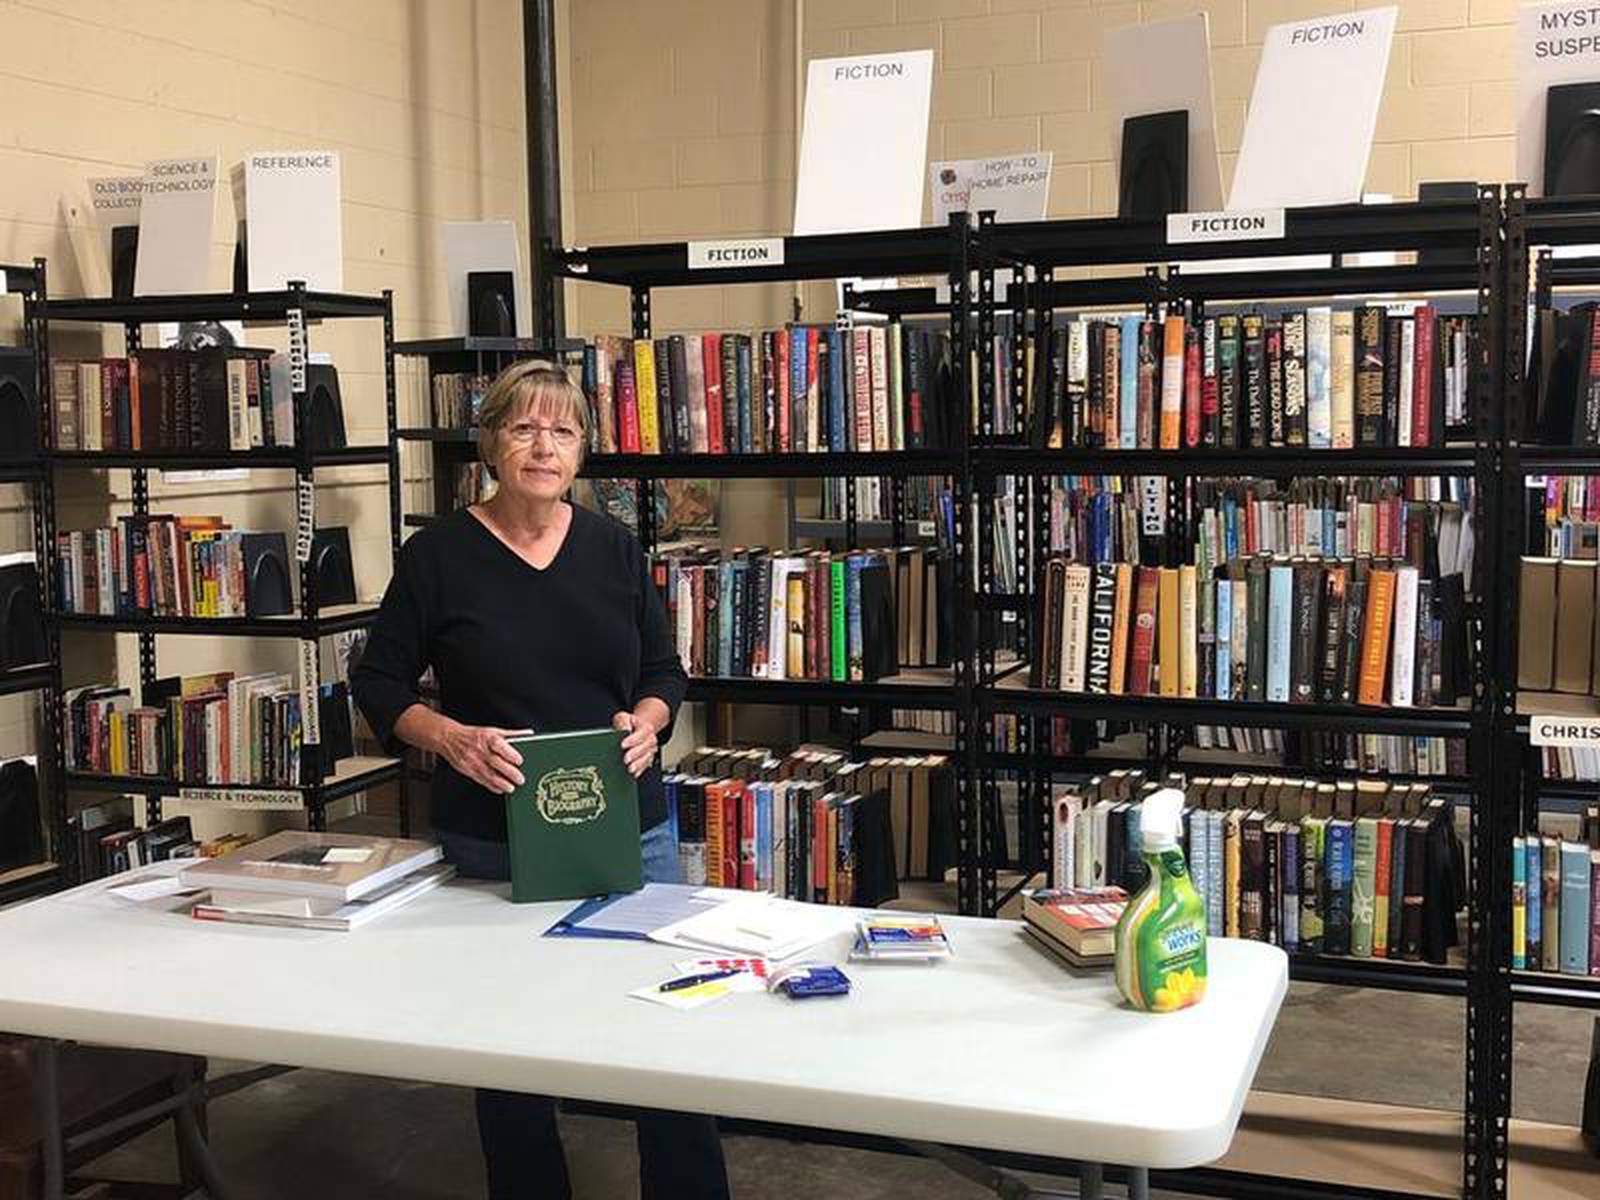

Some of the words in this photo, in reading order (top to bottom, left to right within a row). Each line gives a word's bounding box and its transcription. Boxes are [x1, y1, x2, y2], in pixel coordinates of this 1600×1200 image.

[1541, 8, 1600, 30] MYST
[1291, 20, 1365, 45] FICTION
[1536, 35, 1600, 58] SUSPE
[834, 62, 904, 81] FICTION
[153, 163, 198, 178] SCIENCE
[201, 161, 208, 174] &
[252, 154, 333, 170] REFERENCE
[985, 161, 1011, 174] HOW
[1023, 156, 1038, 169] TO
[95, 181, 116, 195] OLD
[143, 178, 217, 194] TECHNOLOGY
[972, 175, 1004, 190] HOME
[1191, 215, 1266, 233] FICTION
[707, 245, 769, 262] FICTION
[1284, 359, 1299, 416] SEASONS
[1088, 563, 1115, 693] CALIFORNIA
[303, 641, 314, 687] FOREIGN
[305, 688, 317, 743] LANGUAGE
[1540, 724, 1600, 740] CHRIS
[183, 790, 222, 802] SCIENCE
[235, 792, 301, 805] TECHNOLOGY
